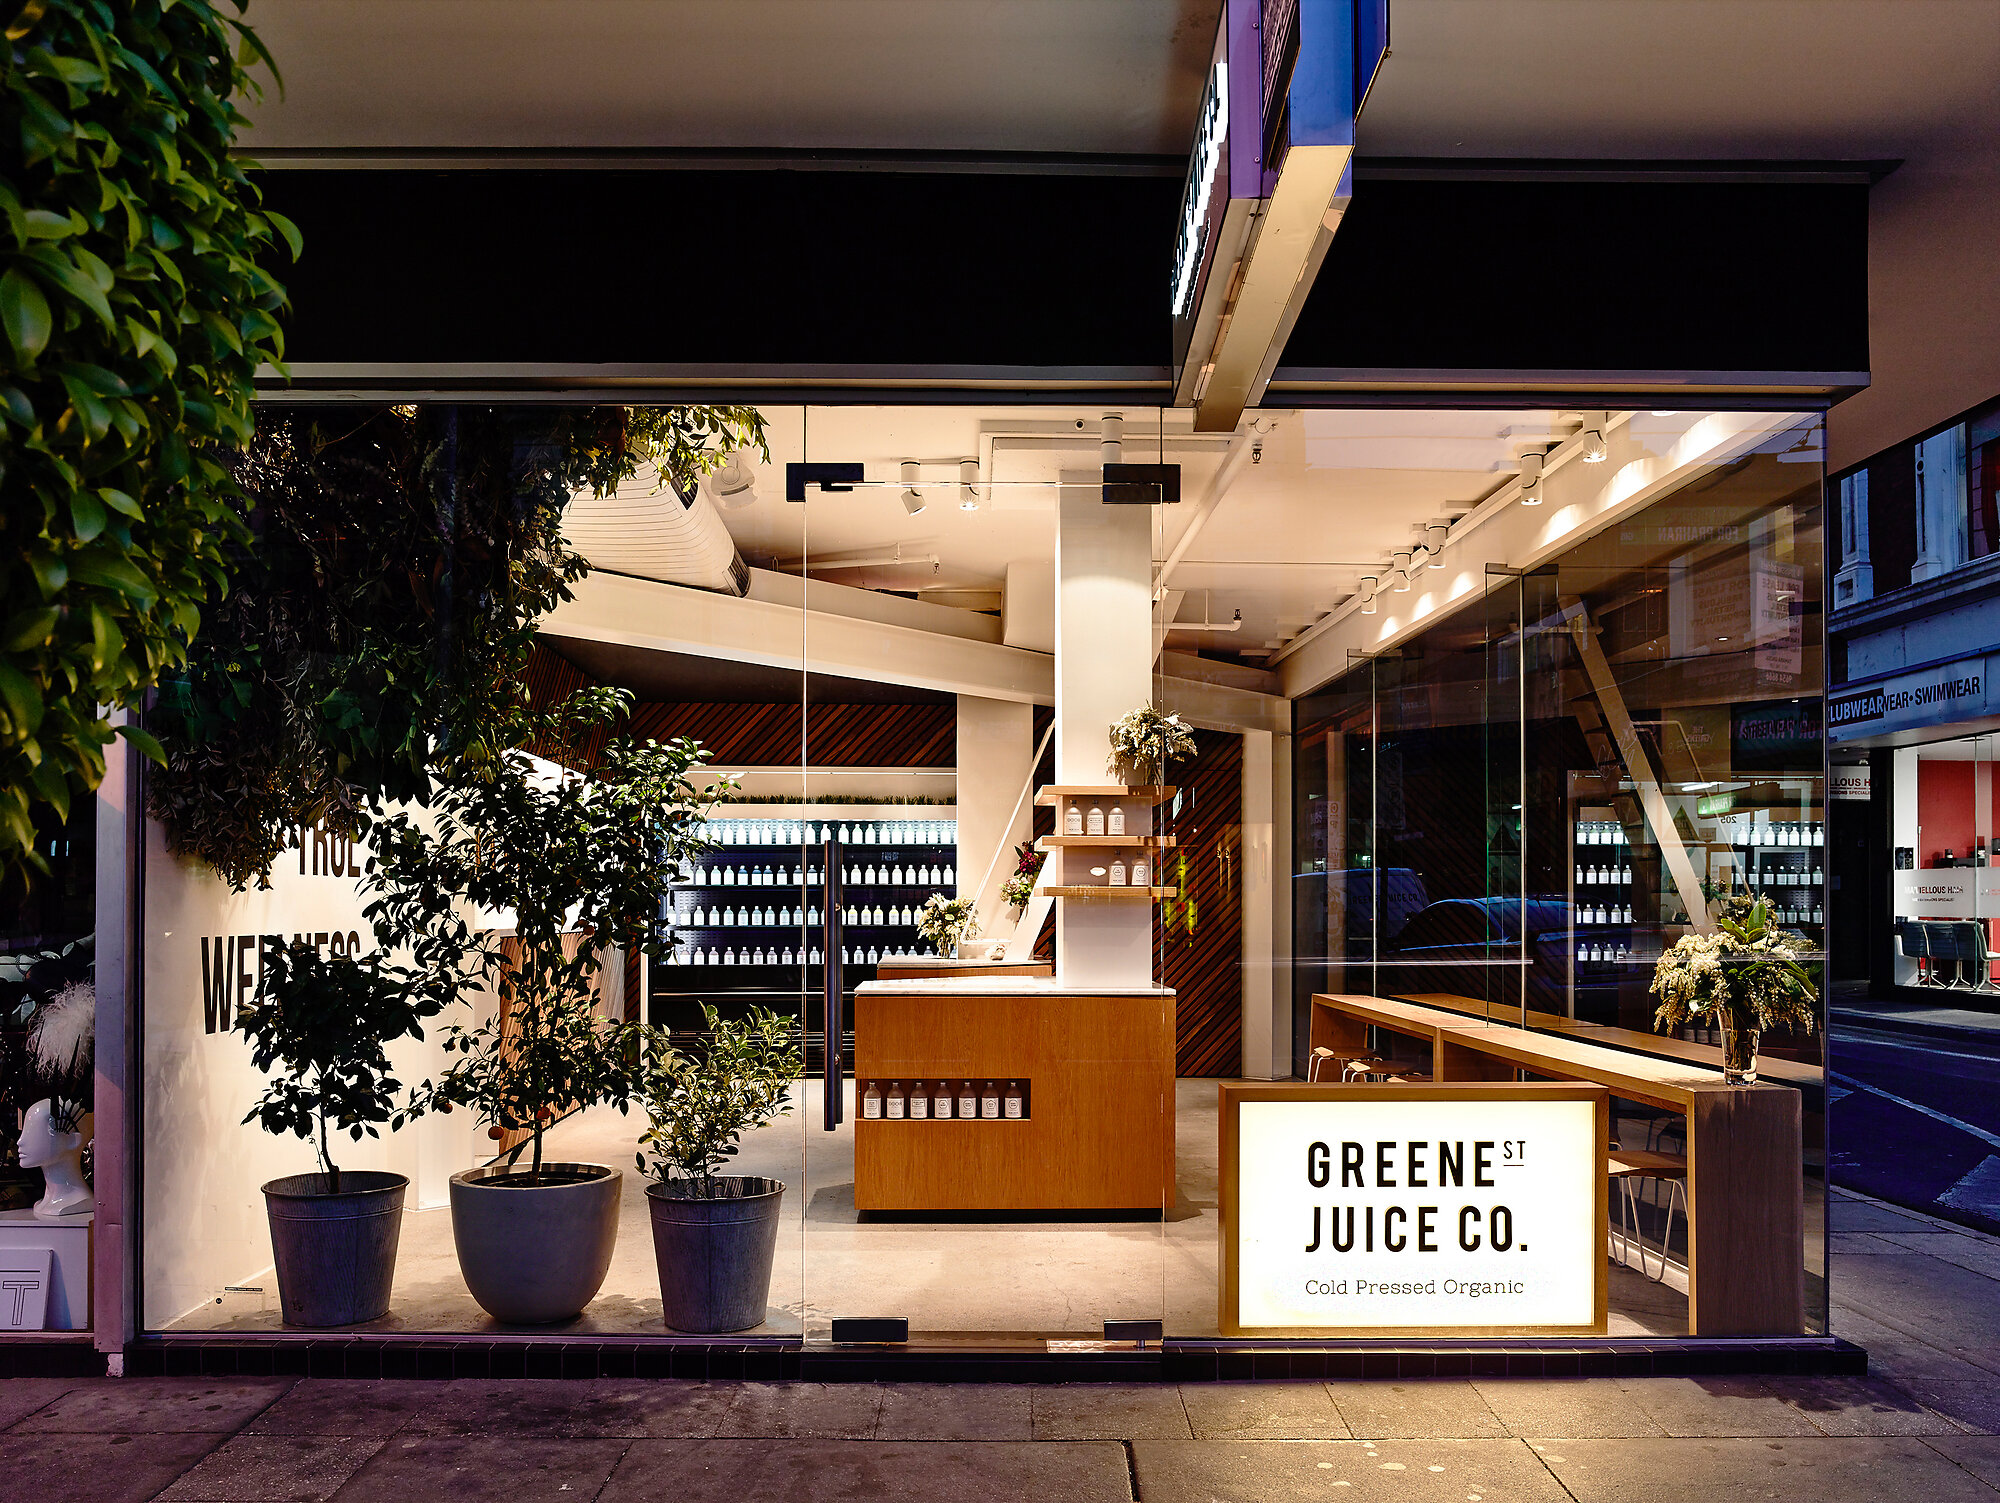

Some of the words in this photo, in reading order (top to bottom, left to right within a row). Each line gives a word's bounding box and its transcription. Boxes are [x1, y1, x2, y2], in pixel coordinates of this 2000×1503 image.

[1828, 694, 1884, 722] LUBWEAR
[1307, 1140, 1495, 1188] GREENE
[1503, 1140, 1526, 1160] ST
[1305, 1206, 1438, 1252] JUICE
[1458, 1206, 1528, 1252] CO.
[1305, 1280, 1348, 1296] Cold
[1356, 1280, 1436, 1296] Pressed
[1444, 1280, 1524, 1298] Organic
